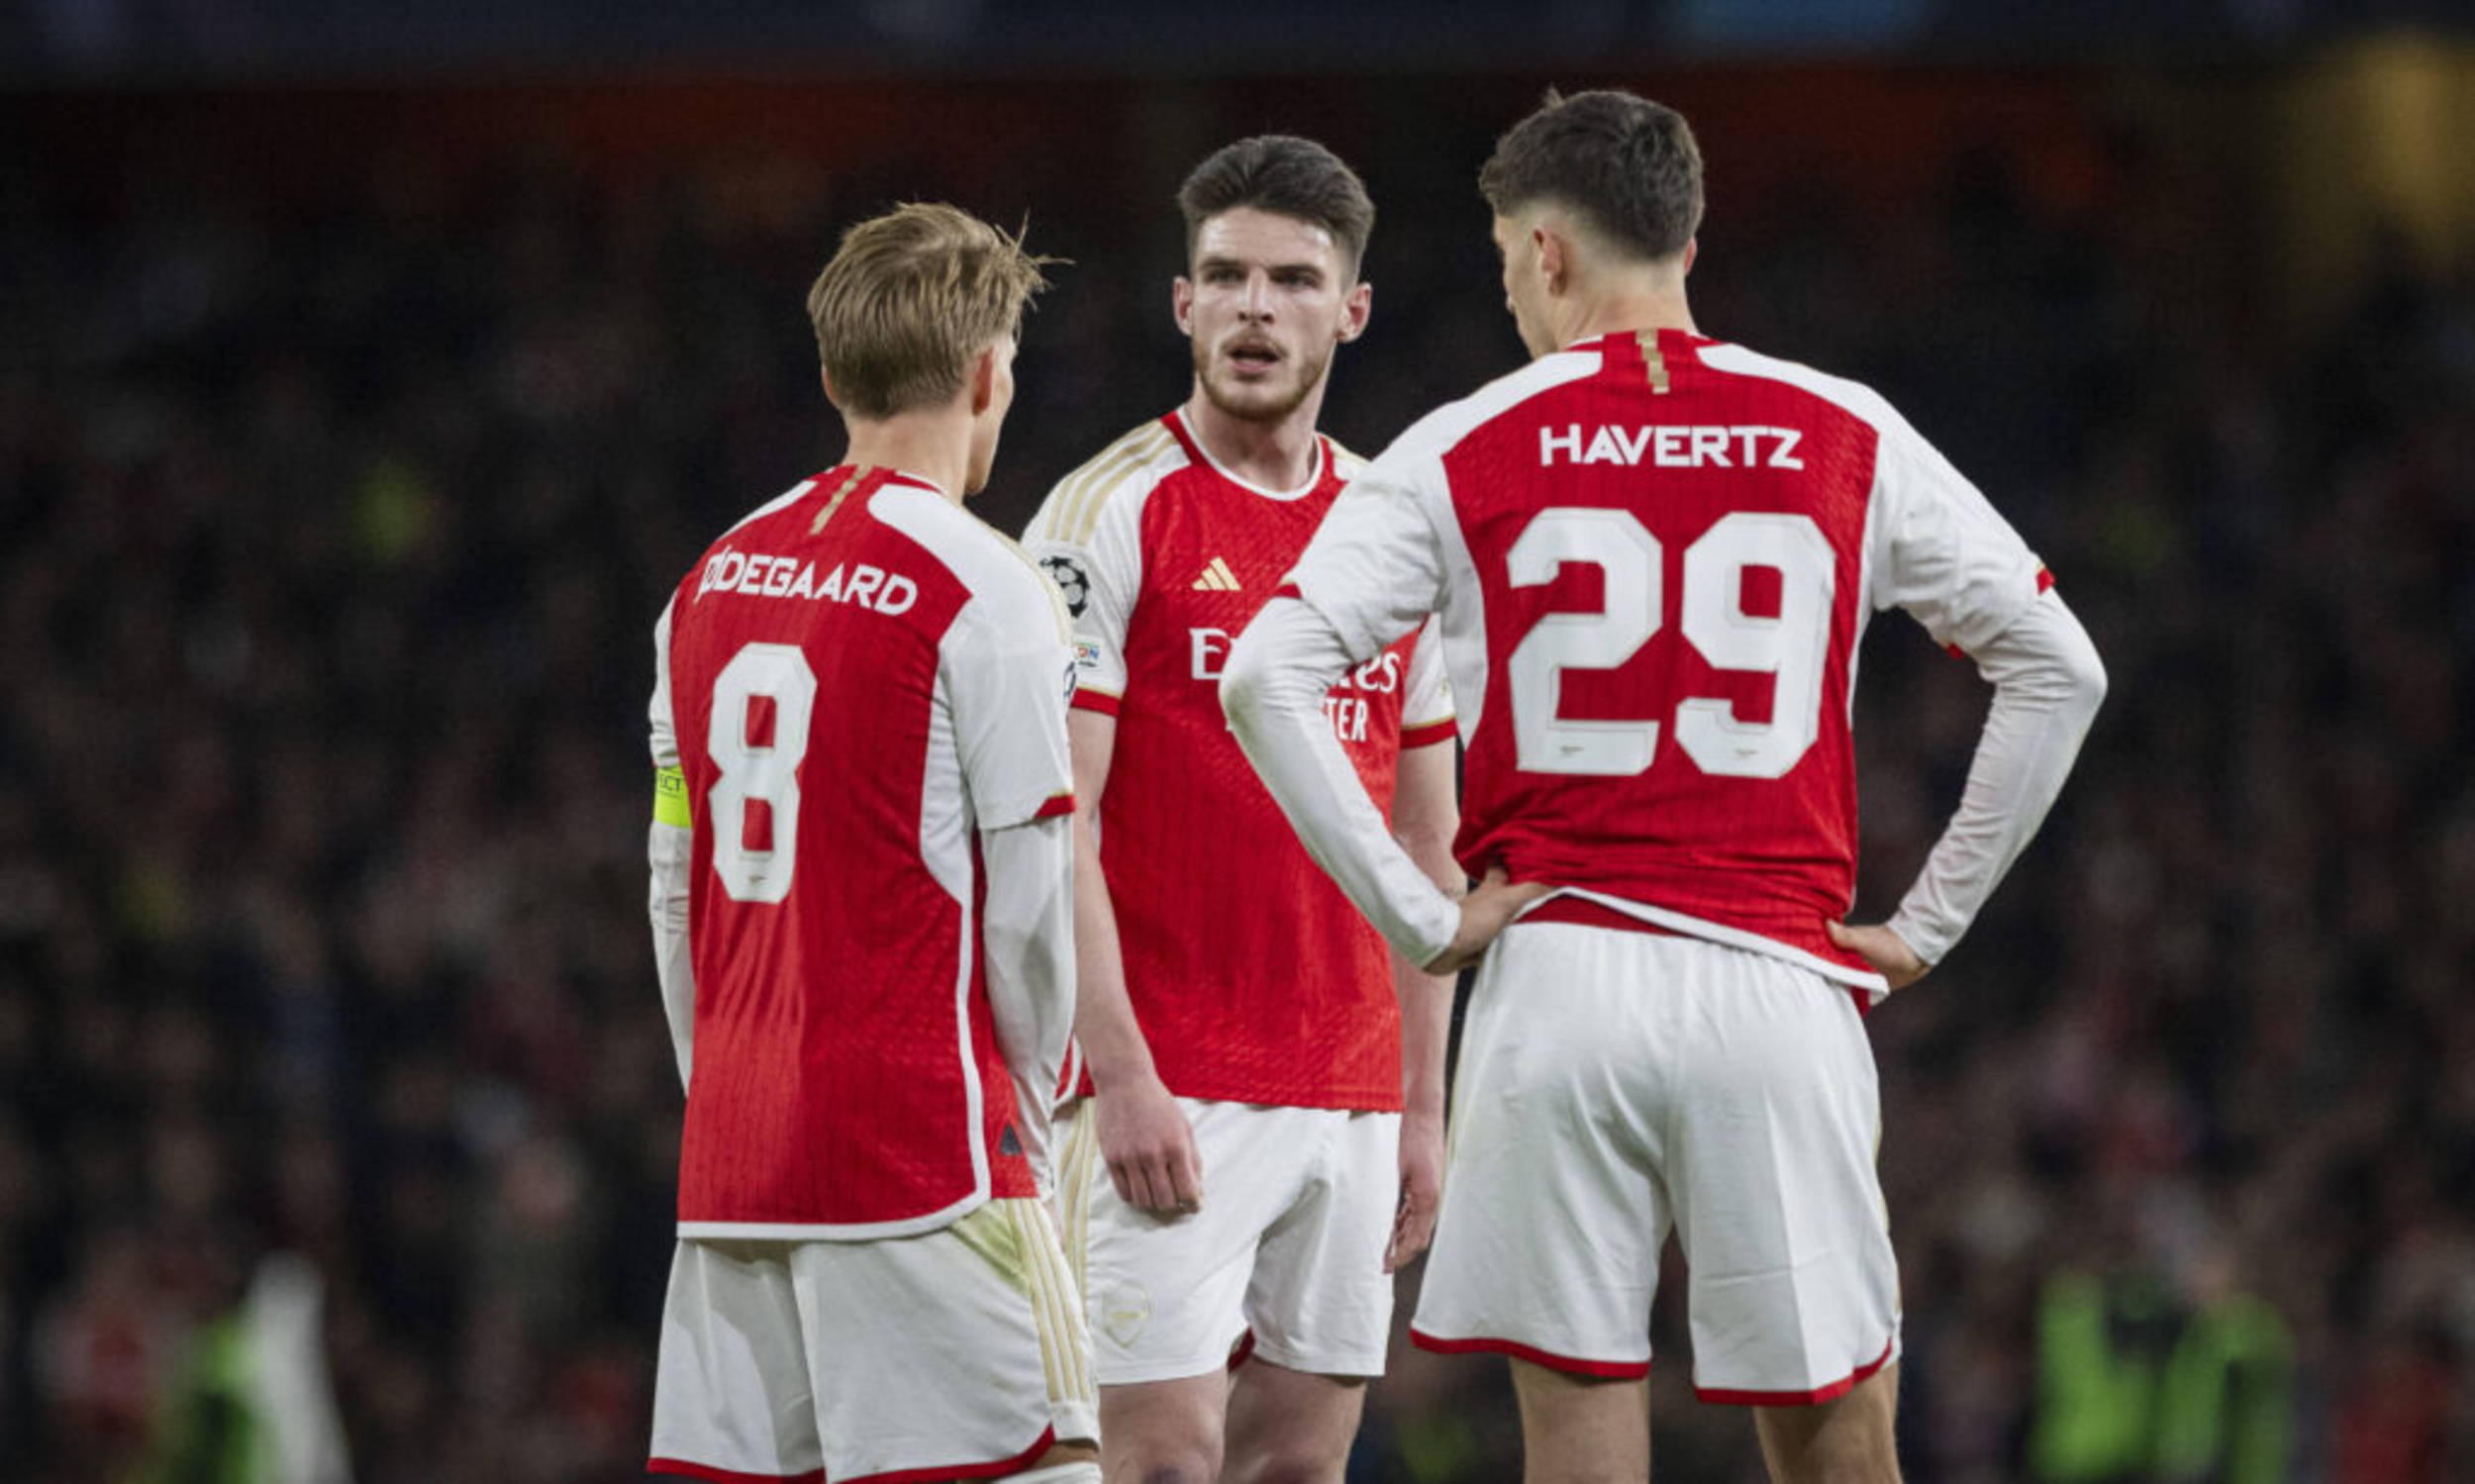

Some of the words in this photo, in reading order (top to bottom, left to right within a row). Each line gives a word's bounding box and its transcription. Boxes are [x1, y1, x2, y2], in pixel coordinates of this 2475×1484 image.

[1539, 423, 1805, 470] HAVERTZ
[694, 544, 919, 616] ØDEGAARD
[1506, 506, 1836, 780] 29
[1324, 697, 1368, 742] TER
[707, 642, 818, 905] 8
